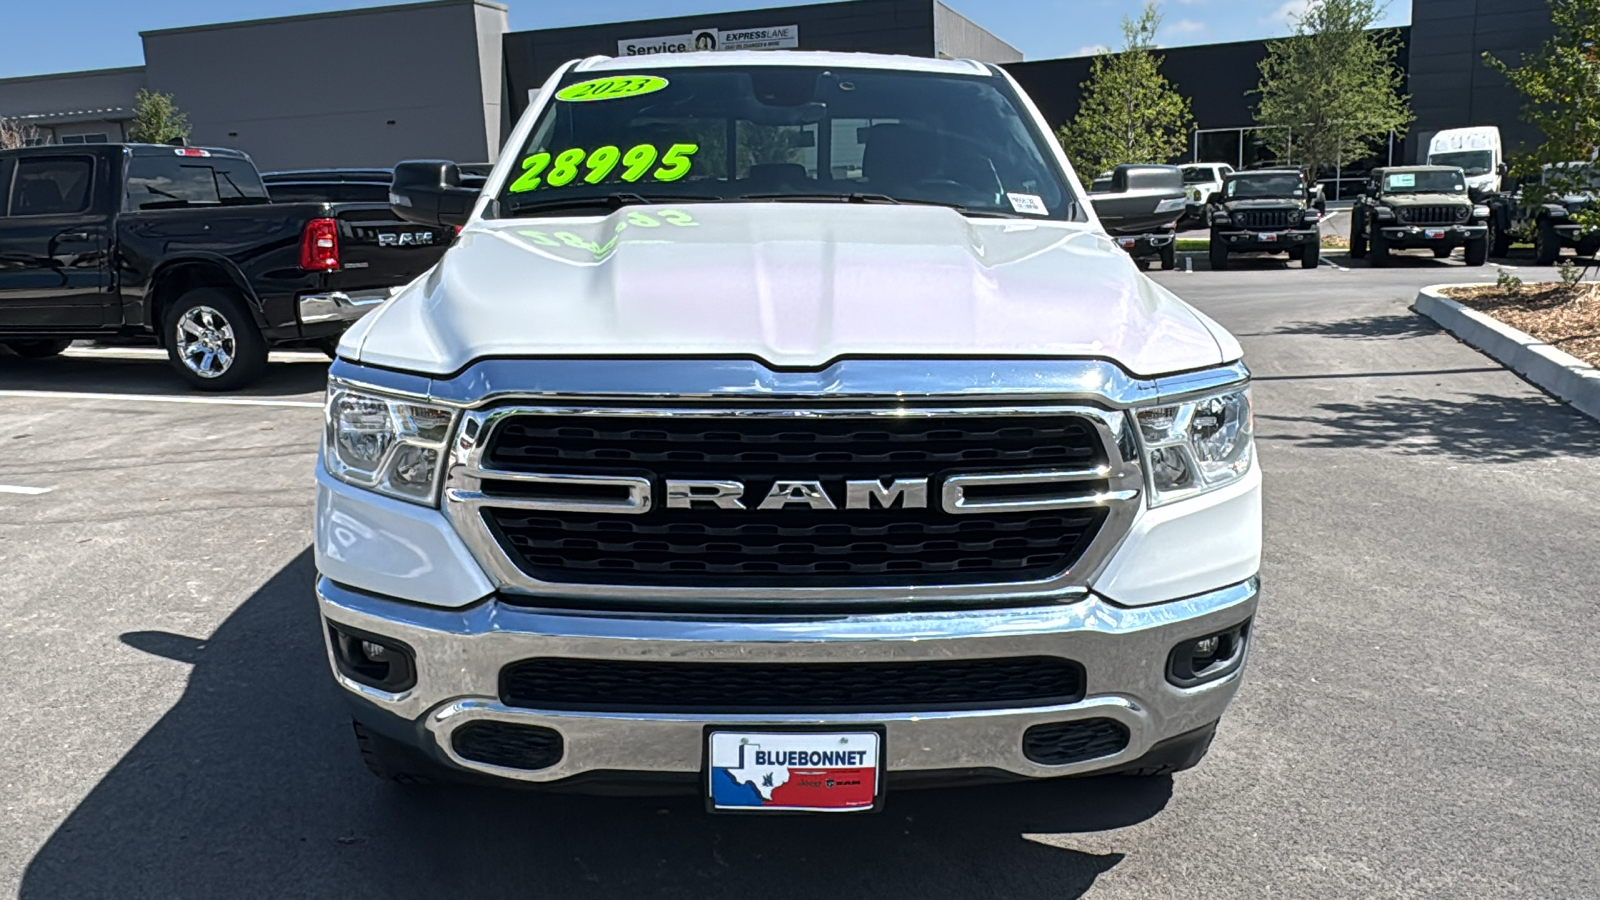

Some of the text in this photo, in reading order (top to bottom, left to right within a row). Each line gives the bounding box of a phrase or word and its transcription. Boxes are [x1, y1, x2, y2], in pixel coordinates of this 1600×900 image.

[626, 42, 686, 56] Service
[571, 78, 652, 98] 2023
[509, 143, 699, 193] 28995
[378, 231, 434, 247] RAM
[665, 477, 929, 510] RAM
[755, 750, 867, 766] BLUEBONNET
